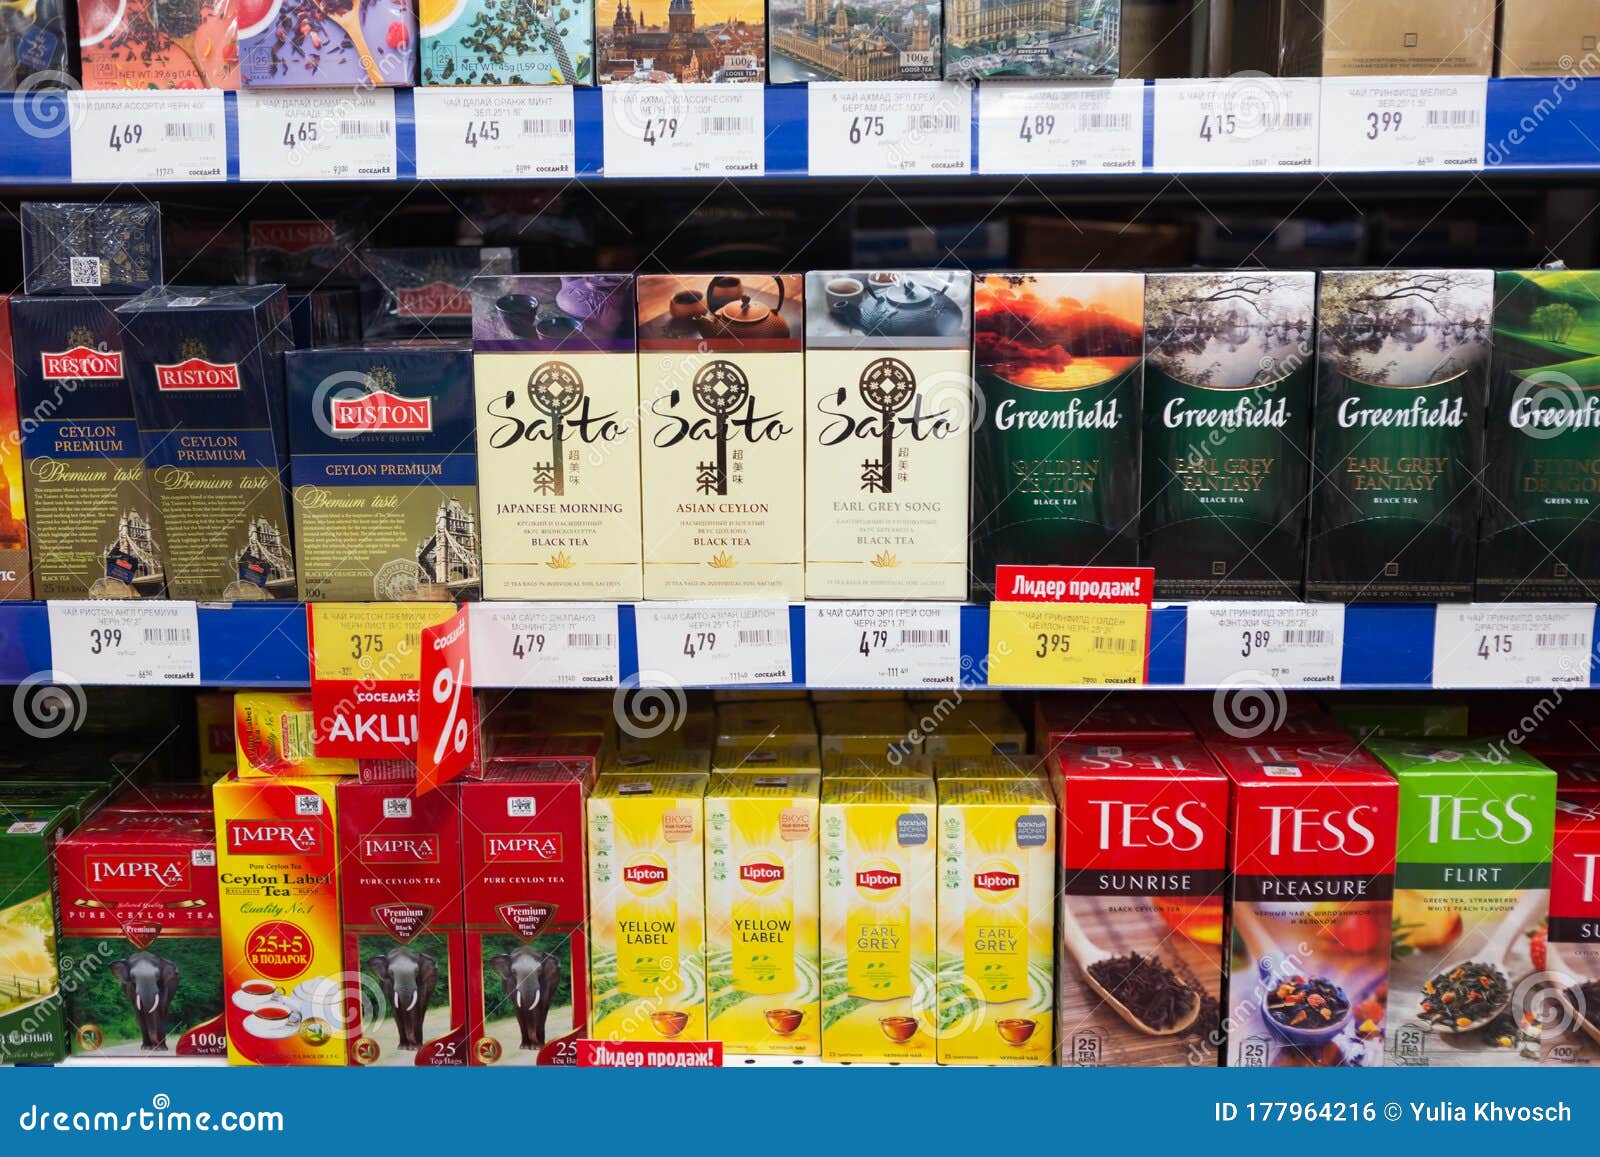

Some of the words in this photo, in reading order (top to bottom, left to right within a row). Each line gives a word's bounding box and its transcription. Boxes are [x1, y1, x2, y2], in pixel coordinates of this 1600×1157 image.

[731, 57, 752, 68] 100g
[906, 53, 928, 65] 100g
[461, 62, 480, 72] NET
[48, 357, 118, 374] RISTON
[163, 369, 235, 386] RISTON
[339, 405, 426, 425] RISTON
[651, 389, 793, 448] Saito
[818, 387, 959, 446] Saito
[995, 397, 1119, 430] Greenfield
[1163, 397, 1288, 429] Greenfield
[1338, 396, 1464, 428] Greenfield
[487, 389, 629, 449] Saito
[59, 426, 116, 438] CEYLON
[54, 440, 124, 452] PREMIUM
[180, 436, 238, 447] CEYLON
[177, 449, 246, 461] PREMIUM
[30, 456, 107, 483] Premium
[113, 467, 143, 482] taste
[325, 464, 377, 476] CEYLON
[380, 464, 443, 475] PREMIUM
[1347, 457, 1392, 475] EARL
[1396, 457, 1449, 475] GREY
[154, 464, 233, 491] Premium
[239, 475, 269, 489] taste
[1184, 476, 1265, 491] FANTASY
[295, 484, 365, 509] Premium
[371, 495, 399, 508] taste
[497, 503, 557, 515] JAPANESE
[559, 503, 623, 514] MORNING
[676, 503, 716, 514] ASIAN
[719, 503, 769, 514] CEYLON
[833, 501, 865, 512] EARL
[868, 501, 900, 512] GREY
[904, 501, 941, 512] SONG
[531, 538, 565, 546] BLACK
[568, 538, 589, 546] TEA
[693, 538, 729, 546] BLACK
[731, 538, 751, 546] TEA
[857, 536, 892, 545] BLACK
[894, 536, 914, 545] TEA
[1011, 574, 1066, 600] Лидер
[1069, 576, 1141, 600] продаж!
[357, 692, 406, 703] СОСЕДИ
[1418, 793, 1532, 844] TESS
[1088, 801, 1204, 851] TESS
[1259, 806, 1375, 856] TESS
[233, 827, 316, 851] IMPRA
[366, 839, 433, 859] IMPRA
[489, 838, 556, 859] IMPRA
[92, 861, 184, 887] IMPRA
[627, 867, 664, 881] Lipton
[743, 866, 781, 879] Lipton
[1444, 868, 1501, 882] FLIRT
[221, 873, 278, 886] Ceylon
[283, 873, 331, 884] Label
[859, 873, 898, 887] Lipton
[978, 874, 1016, 888] Lipton
[1099, 875, 1191, 890] SUNRISE
[261, 885, 290, 896] Tea
[1262, 881, 1367, 895] PLEASURE
[240, 901, 284, 917] Quality
[383, 908, 423, 917] Premium
[507, 907, 547, 916] Premium
[390, 917, 418, 925] Quality
[513, 915, 541, 924] Quality
[735, 919, 791, 932] YELLOW
[127, 924, 156, 934] Premium
[619, 920, 675, 933] YELLOW
[862, 927, 897, 937] EARL
[979, 928, 1014, 938] EARL
[256, 935, 303, 953] 25+5
[627, 934, 668, 945] LABEL
[742, 932, 784, 943] LABEL
[857, 938, 900, 950] GREY
[974, 939, 1017, 951] GREY
[252, 954, 258, 964] В
[260, 954, 308, 965] ПОДАРОК
[189, 1034, 227, 1050] 100g
[1079, 1039, 1096, 1050] 25
[1401, 1032, 1419, 1045] 25
[434, 1042, 456, 1056] 25
[648, 1048, 714, 1067] продаж!
